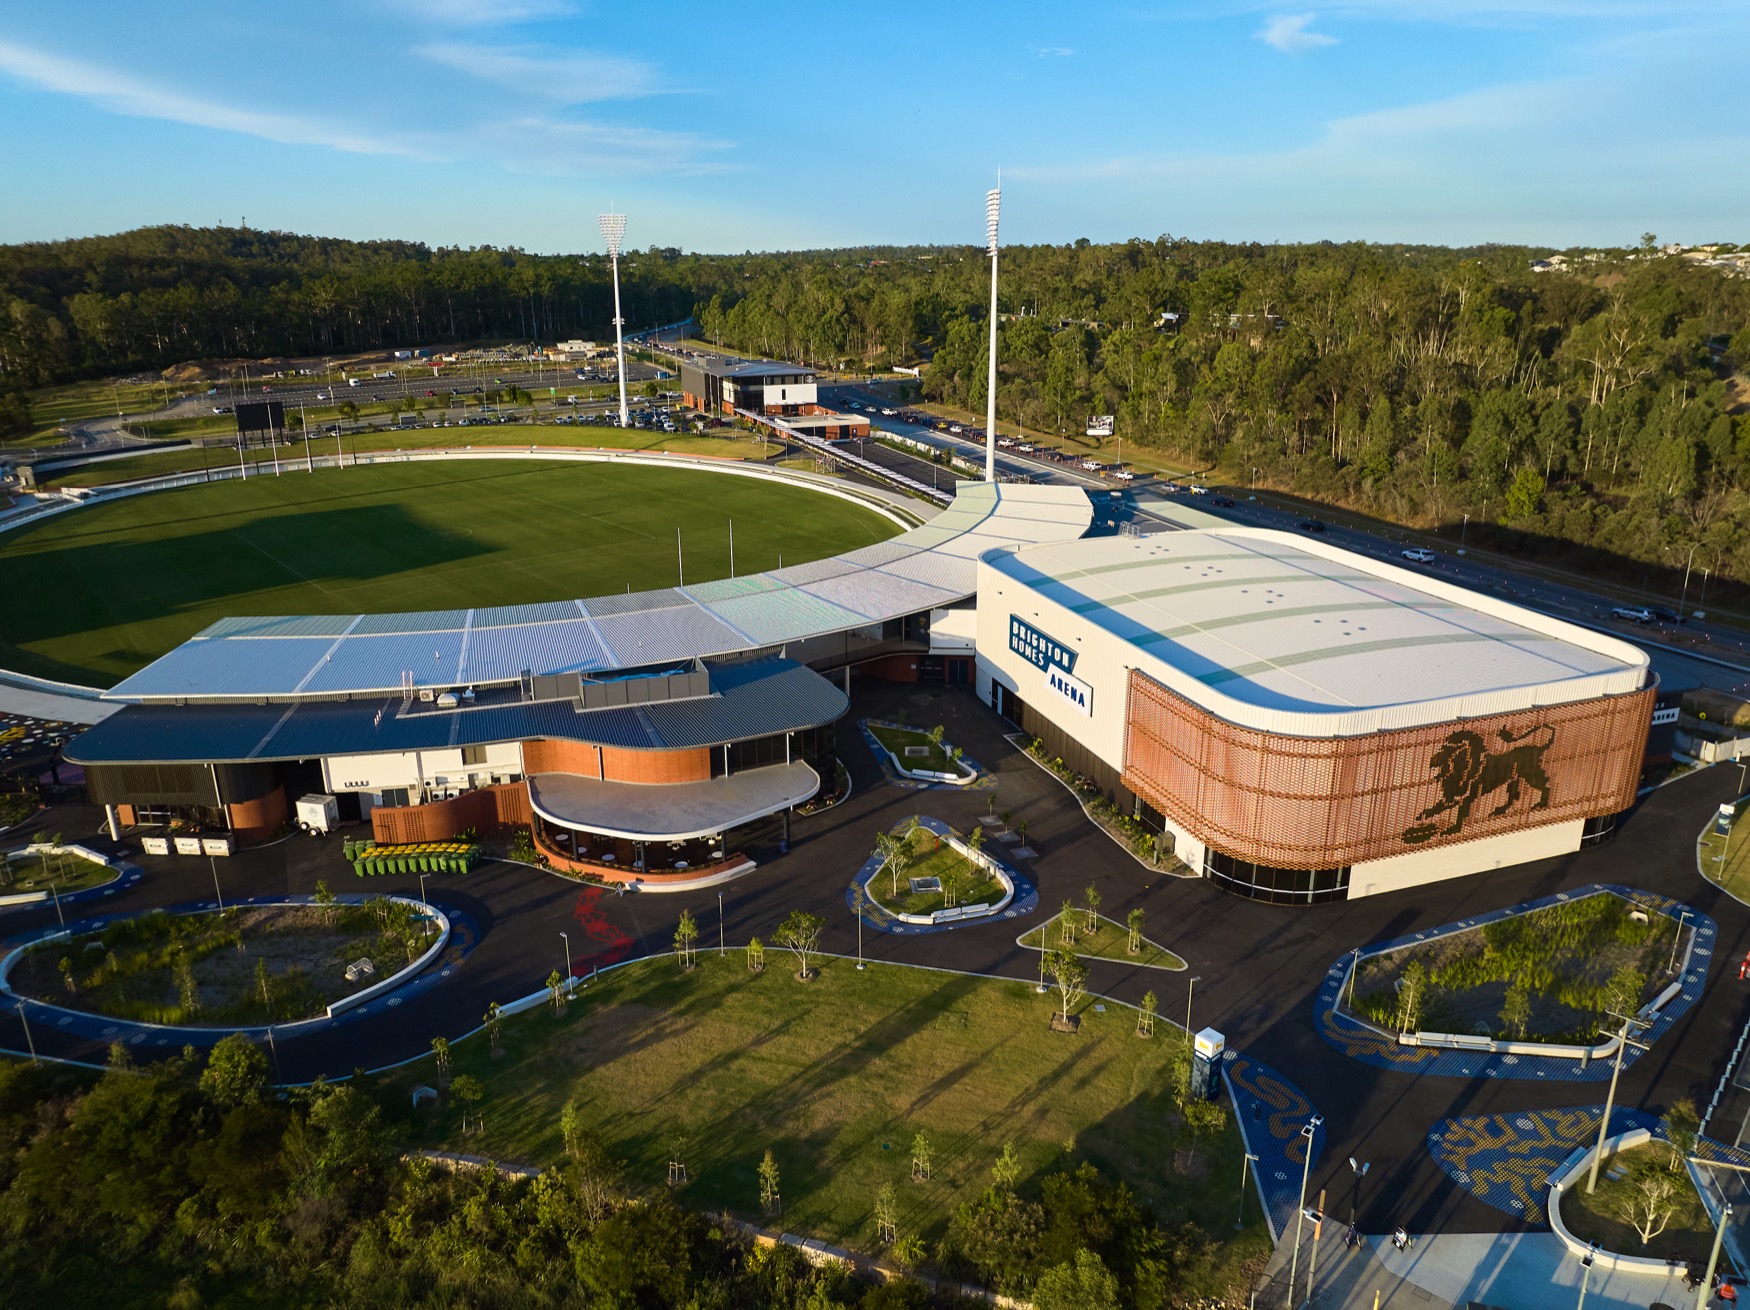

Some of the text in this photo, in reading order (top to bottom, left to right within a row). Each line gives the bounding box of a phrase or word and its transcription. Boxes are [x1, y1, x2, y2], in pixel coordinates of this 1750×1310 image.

[1012, 636, 1044, 666] HOMES
[1013, 621, 1069, 667] BRIGHTON
[1050, 673, 1085, 707] ARENA
